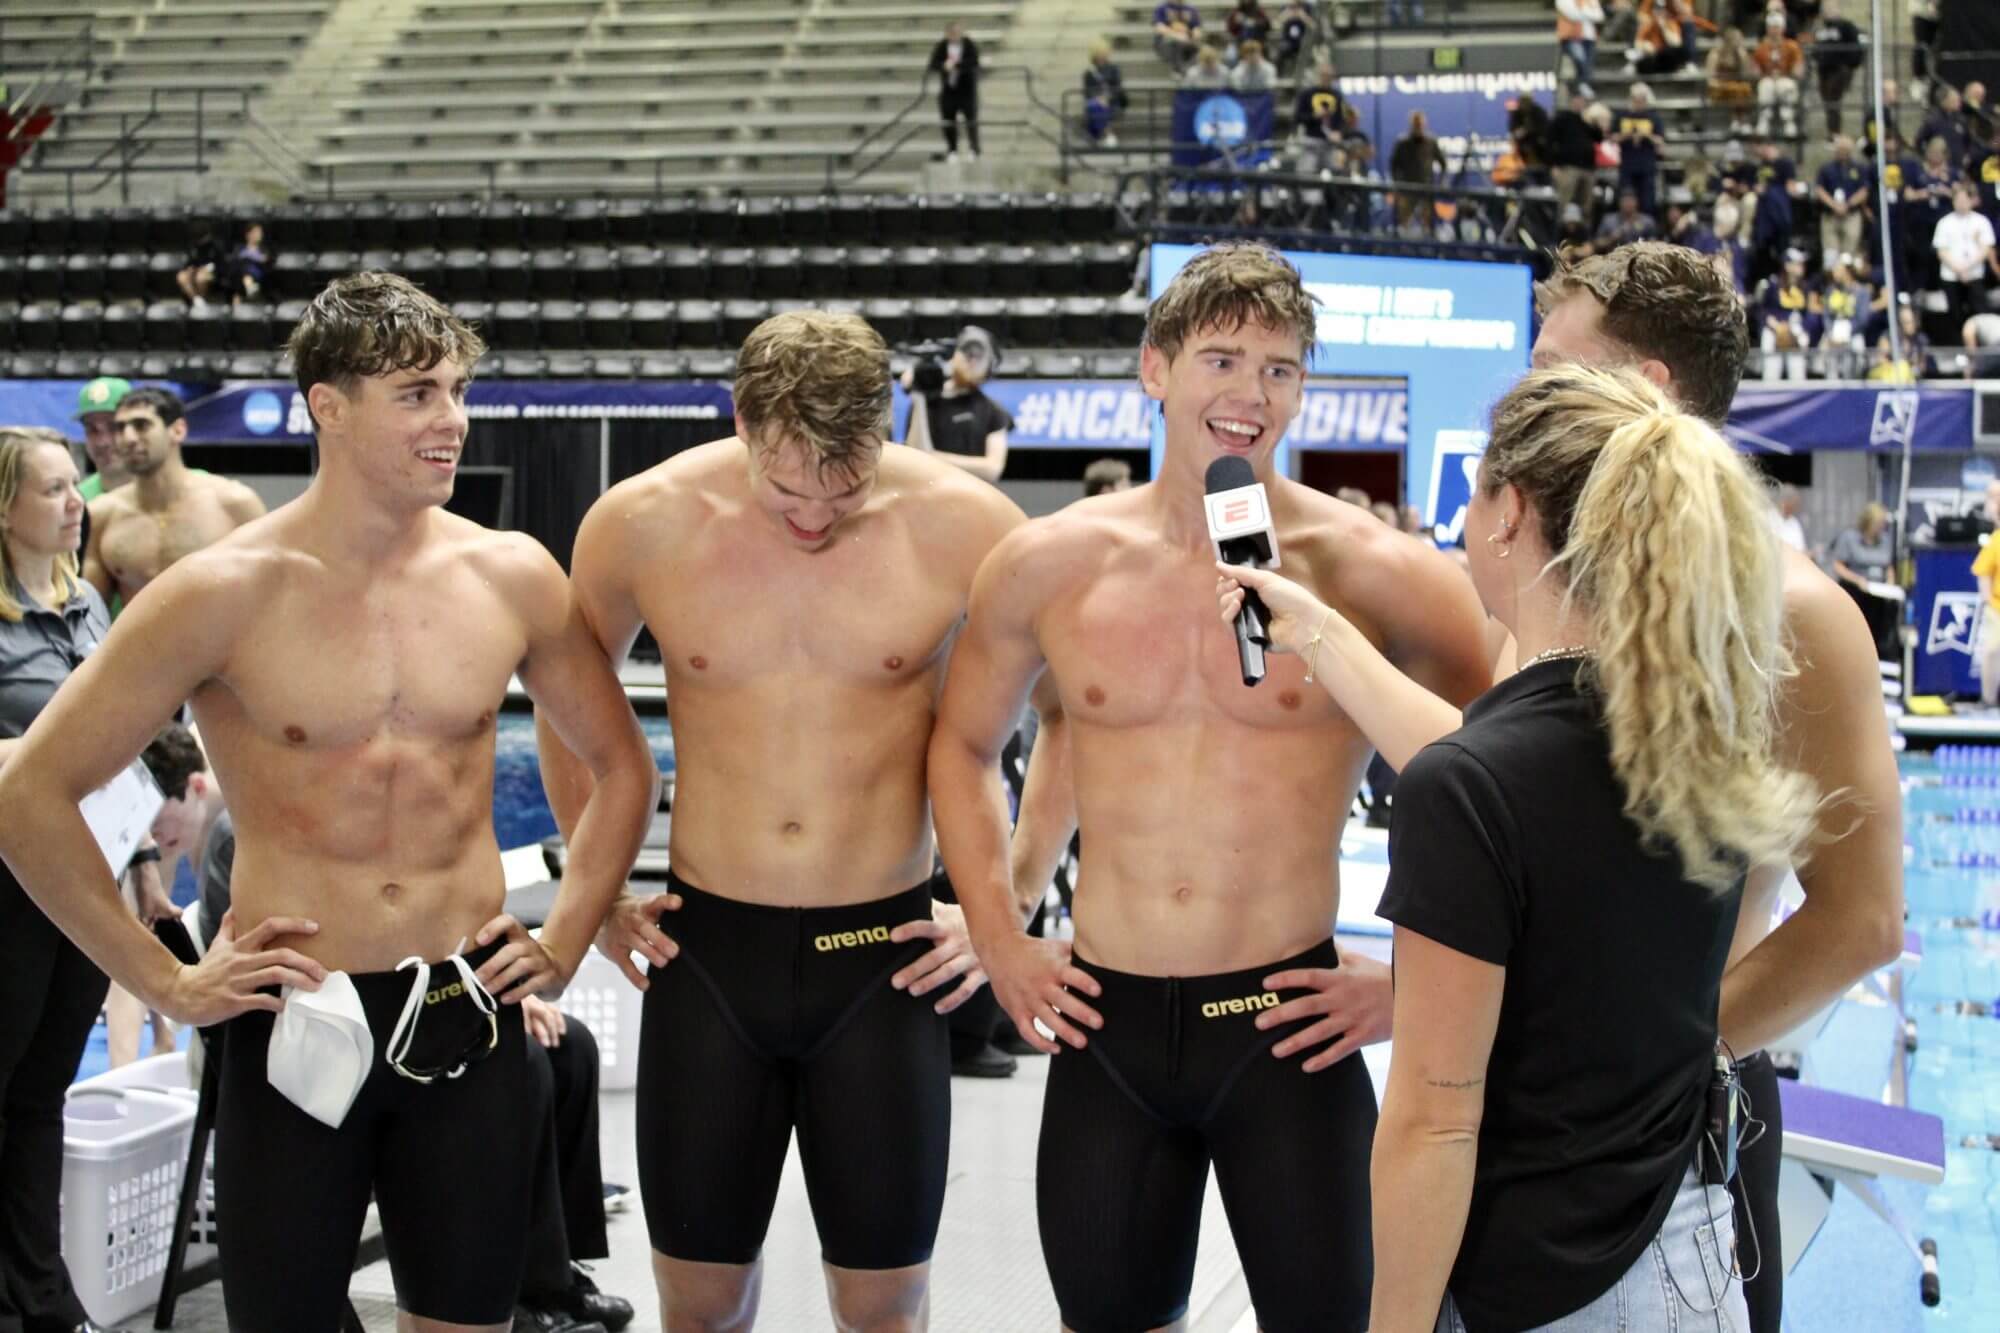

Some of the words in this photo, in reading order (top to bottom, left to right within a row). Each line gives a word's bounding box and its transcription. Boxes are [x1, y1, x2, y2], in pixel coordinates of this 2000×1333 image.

[815, 926, 889, 952] arena
[425, 979, 469, 1005] are
[1201, 991, 1280, 1018] arena
